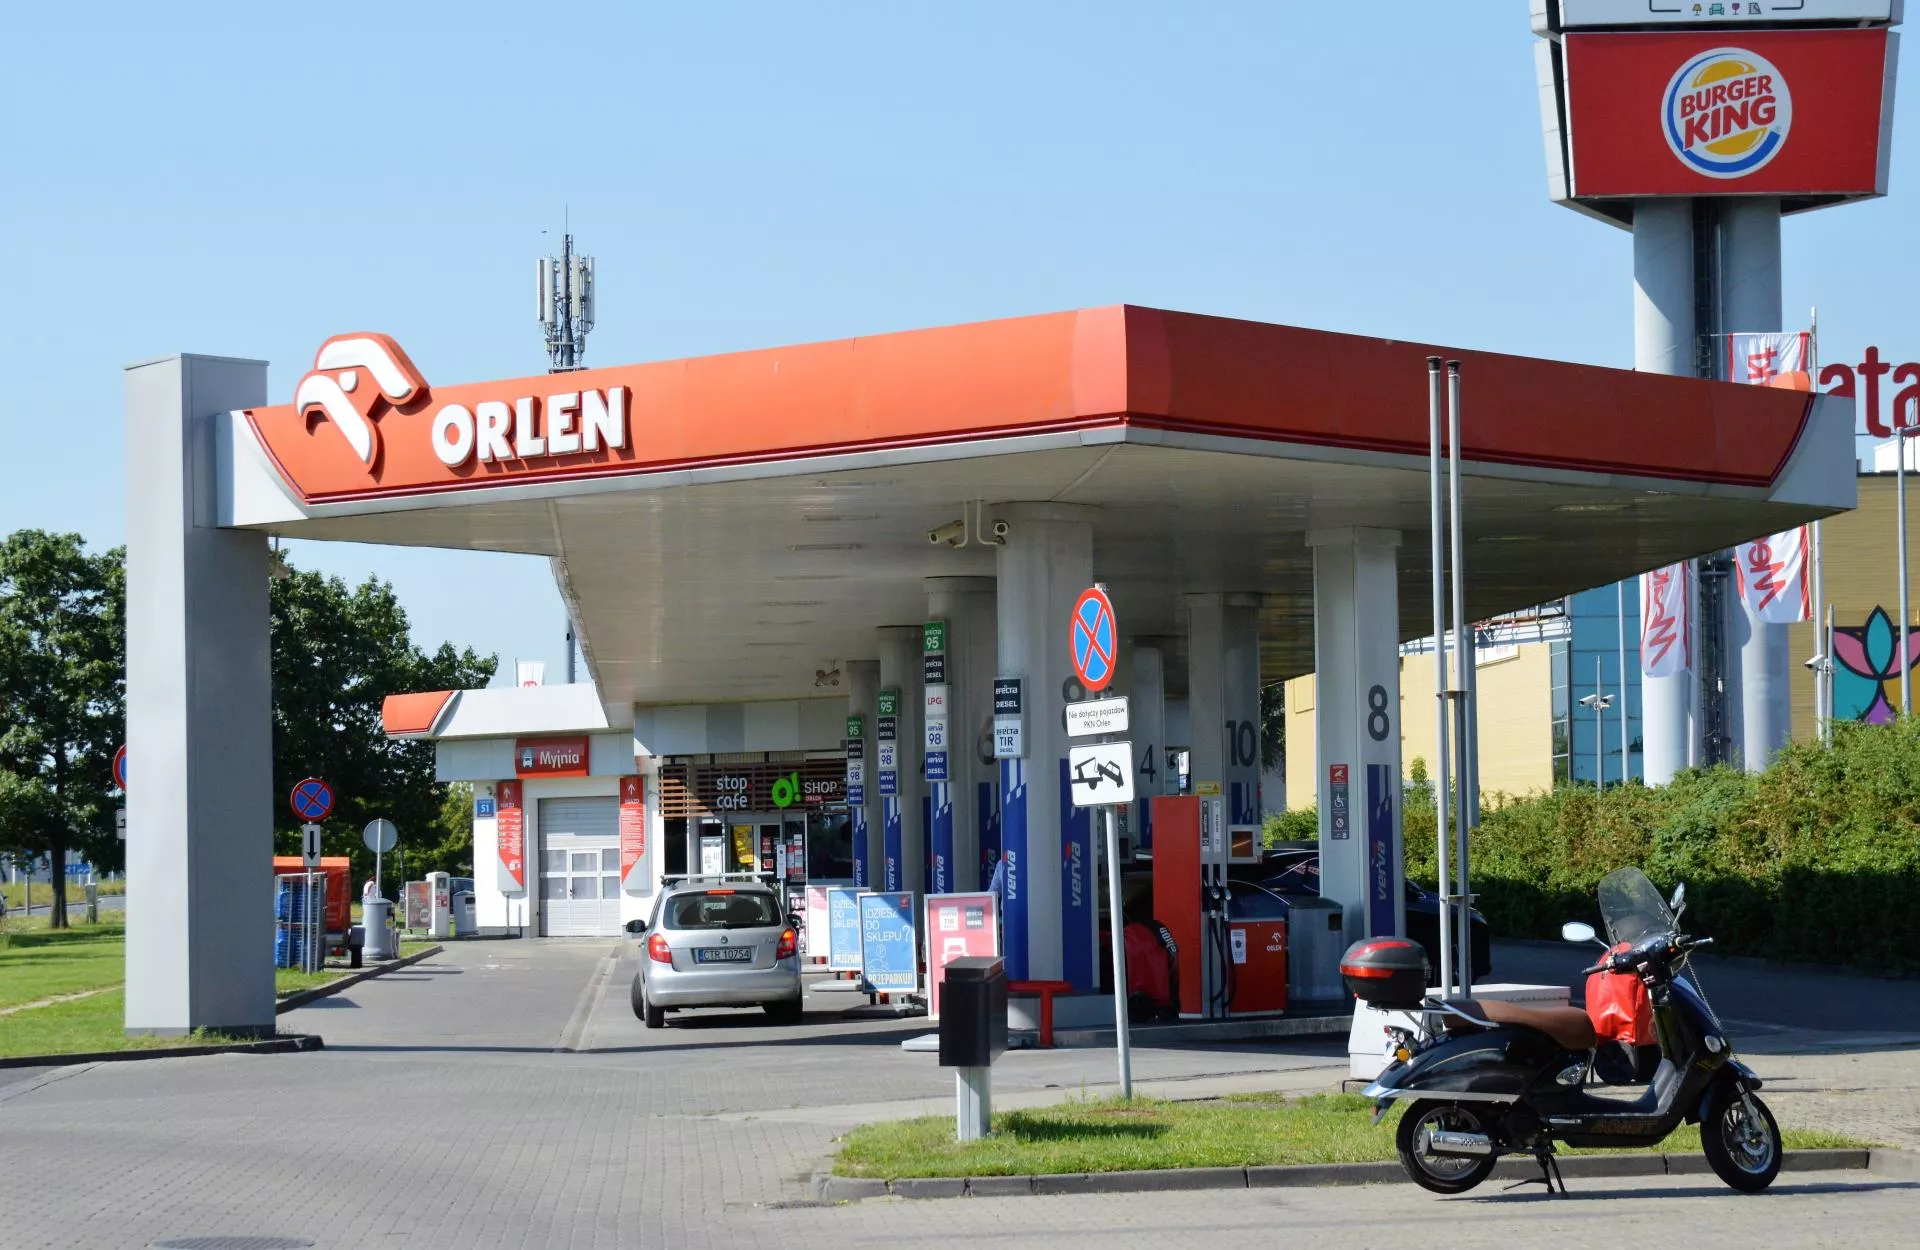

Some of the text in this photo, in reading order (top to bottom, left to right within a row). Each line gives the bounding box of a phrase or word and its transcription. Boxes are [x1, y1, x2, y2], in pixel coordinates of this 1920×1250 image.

[1680, 74, 1773, 119] BURGER
[1683, 95, 1777, 149] KING
[431, 386, 627, 467] ORLEN
[926, 636, 939, 649] 95
[880, 702, 893, 713] 95
[927, 697, 942, 705] LPG
[996, 700, 1018, 708] DIESEL
[1367, 684, 1390, 742] 8
[848, 726, 860, 736] 95
[928, 733, 942, 745] 98
[1000, 736, 1014, 747] TIR
[1225, 719, 1258, 768] 10
[540, 749, 580, 769] Myjnia
[880, 754, 892, 765] 98
[1139, 744, 1157, 785] 4
[849, 771, 860, 781] 98
[804, 781, 838, 794] SHOP
[716, 793, 748, 810] cafe
[480, 804, 490, 813] 51
[936, 855, 945, 894] verva
[1007, 849, 1017, 900] verva
[1071, 840, 1082, 907] verva
[1377, 840, 1387, 900] verva
[865, 907, 898, 919] IDZIESZ
[865, 920, 880, 930] DO
[724, 949, 751, 960] 10754
